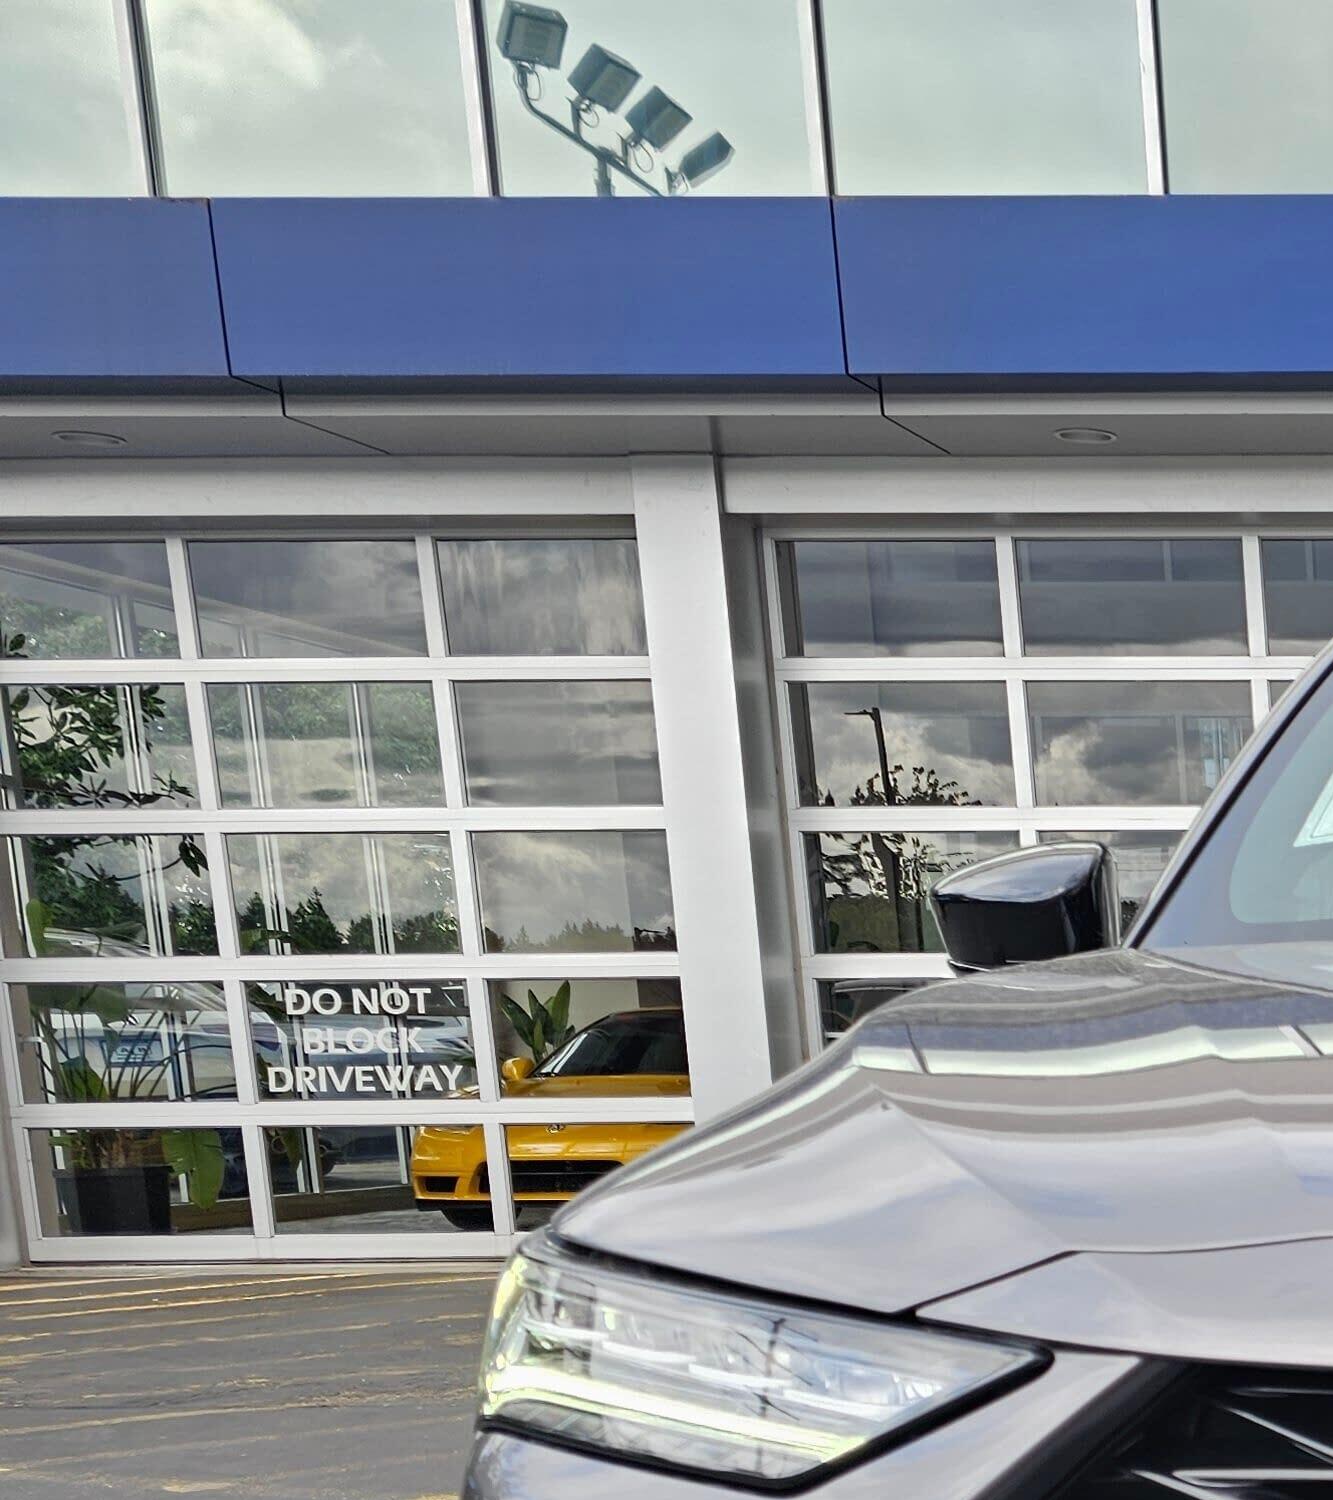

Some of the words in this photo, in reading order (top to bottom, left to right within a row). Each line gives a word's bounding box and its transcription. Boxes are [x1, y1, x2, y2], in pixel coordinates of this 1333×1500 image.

[286, 988, 342, 1015] DO
[353, 987, 431, 1015] NOT
[302, 1027, 425, 1054] BLOCK
[268, 1065, 463, 1093] DRIVEWAY
